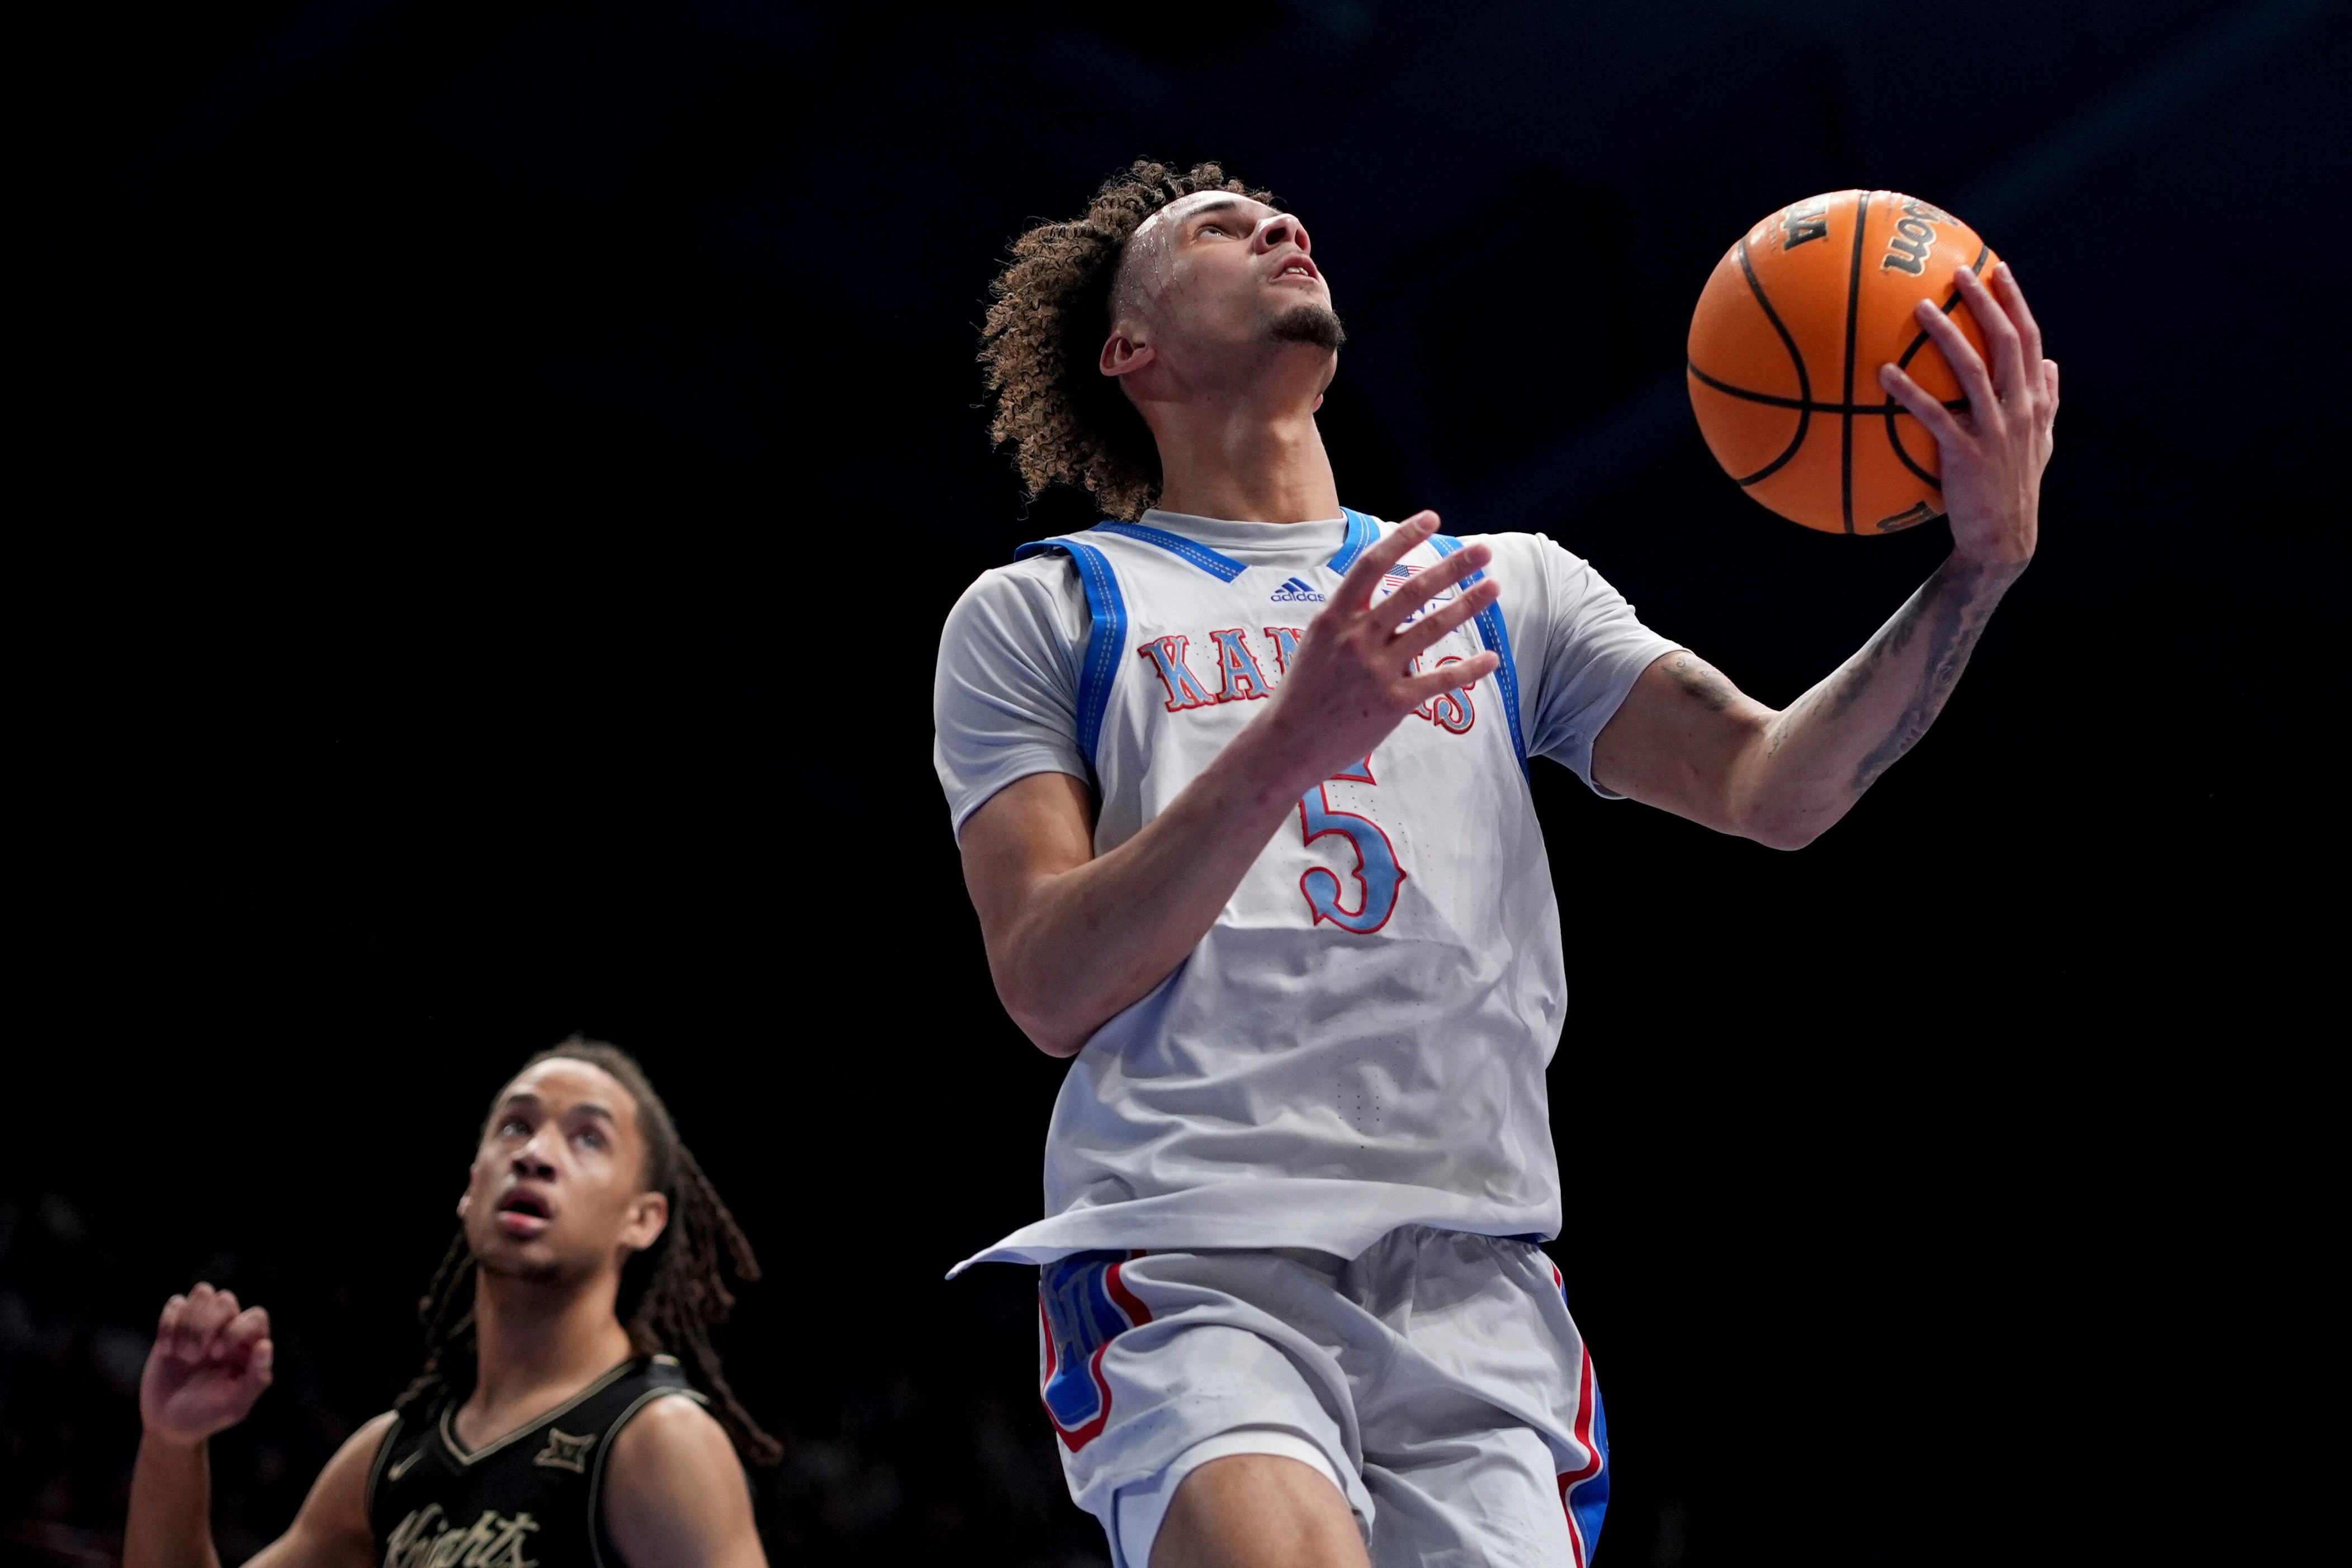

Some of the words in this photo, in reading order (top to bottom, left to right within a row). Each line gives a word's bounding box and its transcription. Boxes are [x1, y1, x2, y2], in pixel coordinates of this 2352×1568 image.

[1880, 200, 1958, 277] son
[1270, 591, 1326, 602] adidas
[1299, 752, 1407, 934] 5
[382, 1502, 541, 1568] Knights
